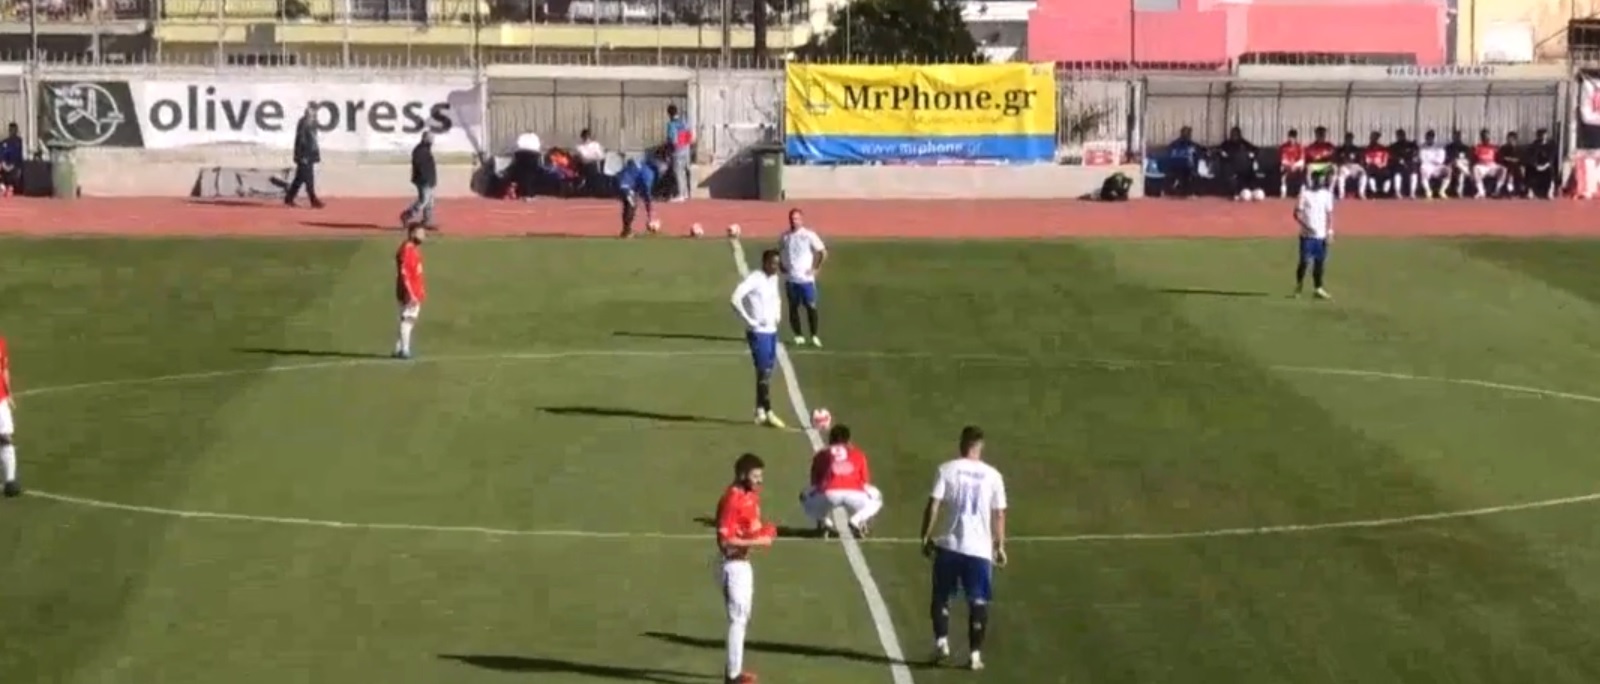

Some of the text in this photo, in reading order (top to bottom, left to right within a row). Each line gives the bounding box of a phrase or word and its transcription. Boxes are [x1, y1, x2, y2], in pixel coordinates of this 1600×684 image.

[148, 86, 453, 134] olive press
[842, 84, 1037, 116] MrPhone.gr
[830, 445, 848, 461] 9
